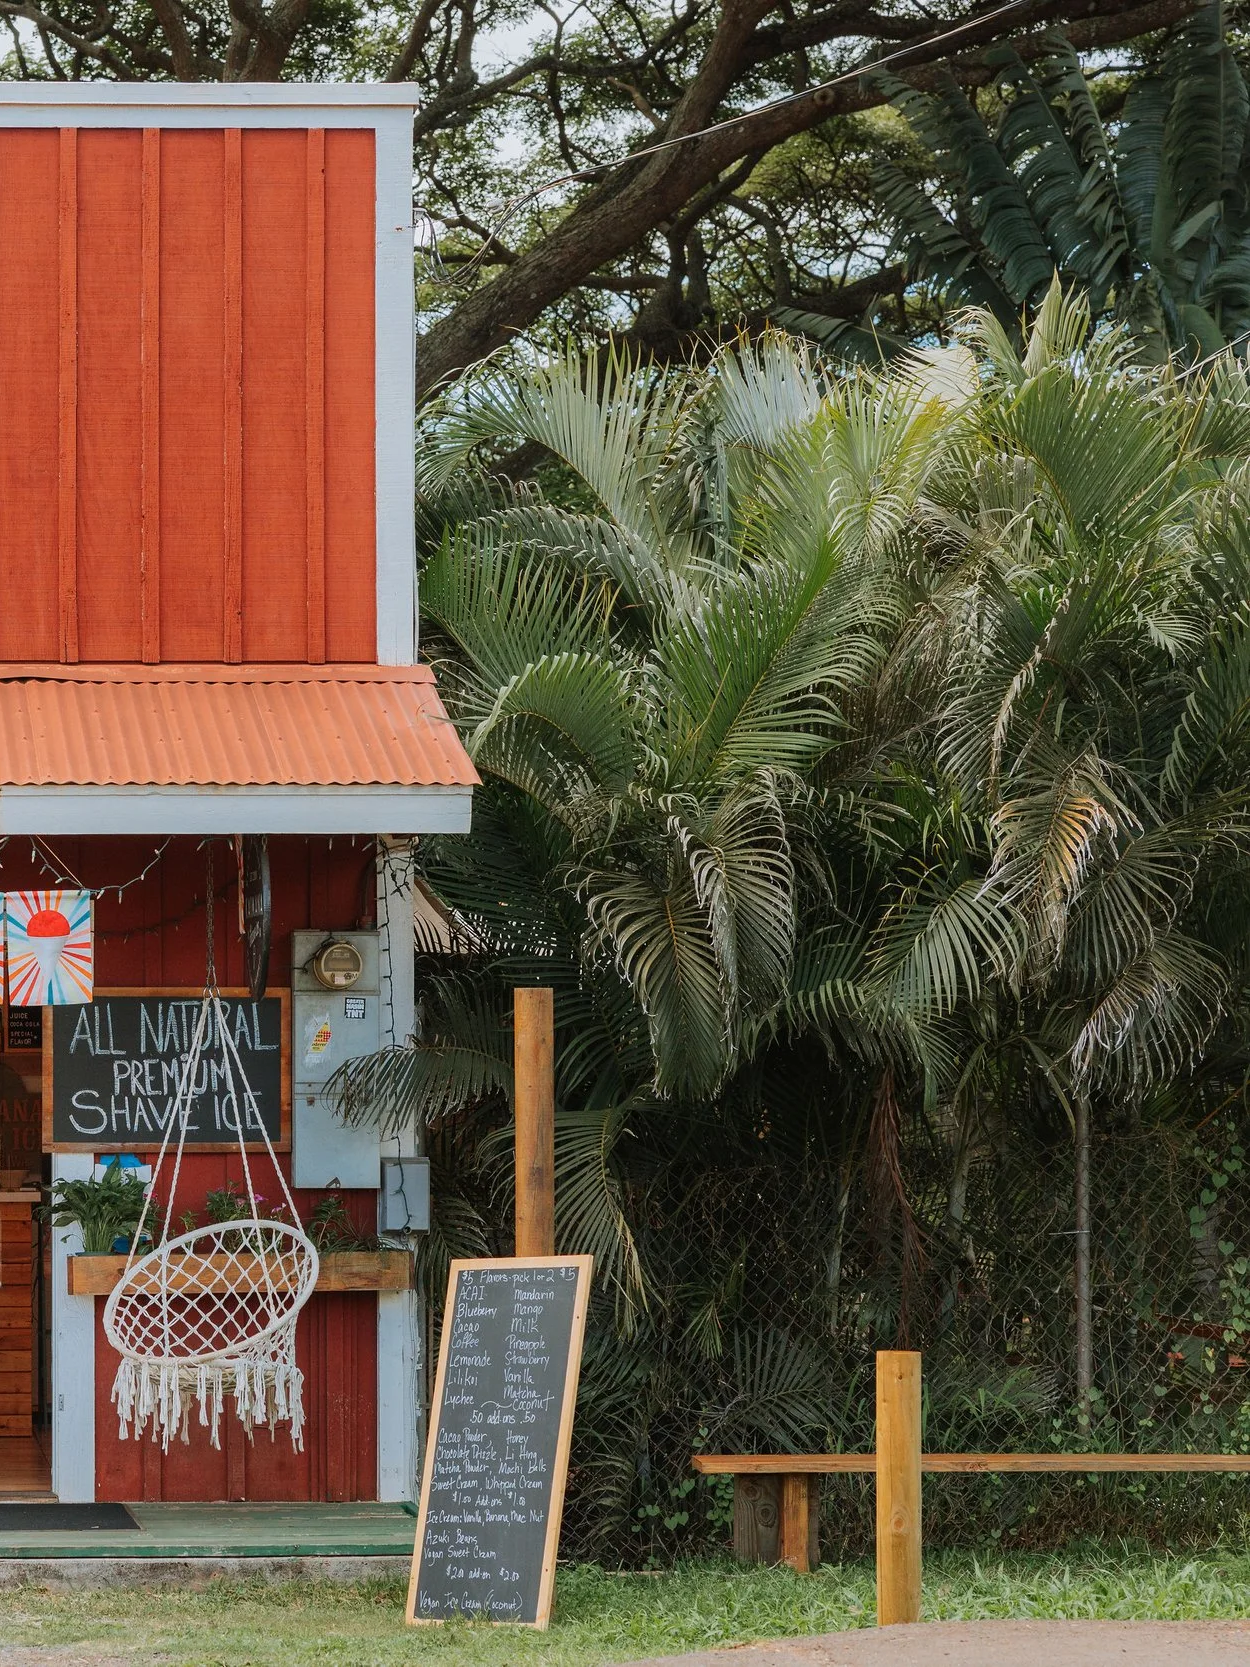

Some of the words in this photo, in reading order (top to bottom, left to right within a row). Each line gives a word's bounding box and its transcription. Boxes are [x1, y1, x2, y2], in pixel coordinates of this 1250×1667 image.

[70, 1003, 126, 1056] ALL
[140, 1000, 279, 1054] NATURAL
[69, 1089, 199, 1135] SHAVE
[214, 1091, 263, 1131] ICE
[461, 1270, 474, 1286] $5
[545, 1269, 555, 1283] 2
[559, 1267, 576, 1281] $5
[458, 1285, 486, 1302] ACAI
[456, 1302, 498, 1319] Blueberry
[513, 1303, 544, 1320] Mango
[453, 1319, 480, 1333] Cacao
[510, 1317, 540, 1334] Milk
[451, 1332, 480, 1349] Coffee
[505, 1334, 546, 1356] Pineapple
[449, 1350, 492, 1368] Lemonade
[504, 1350, 550, 1372] Strawberry
[504, 1367, 535, 1384] Vanilla
[444, 1387, 475, 1410] Lychee
